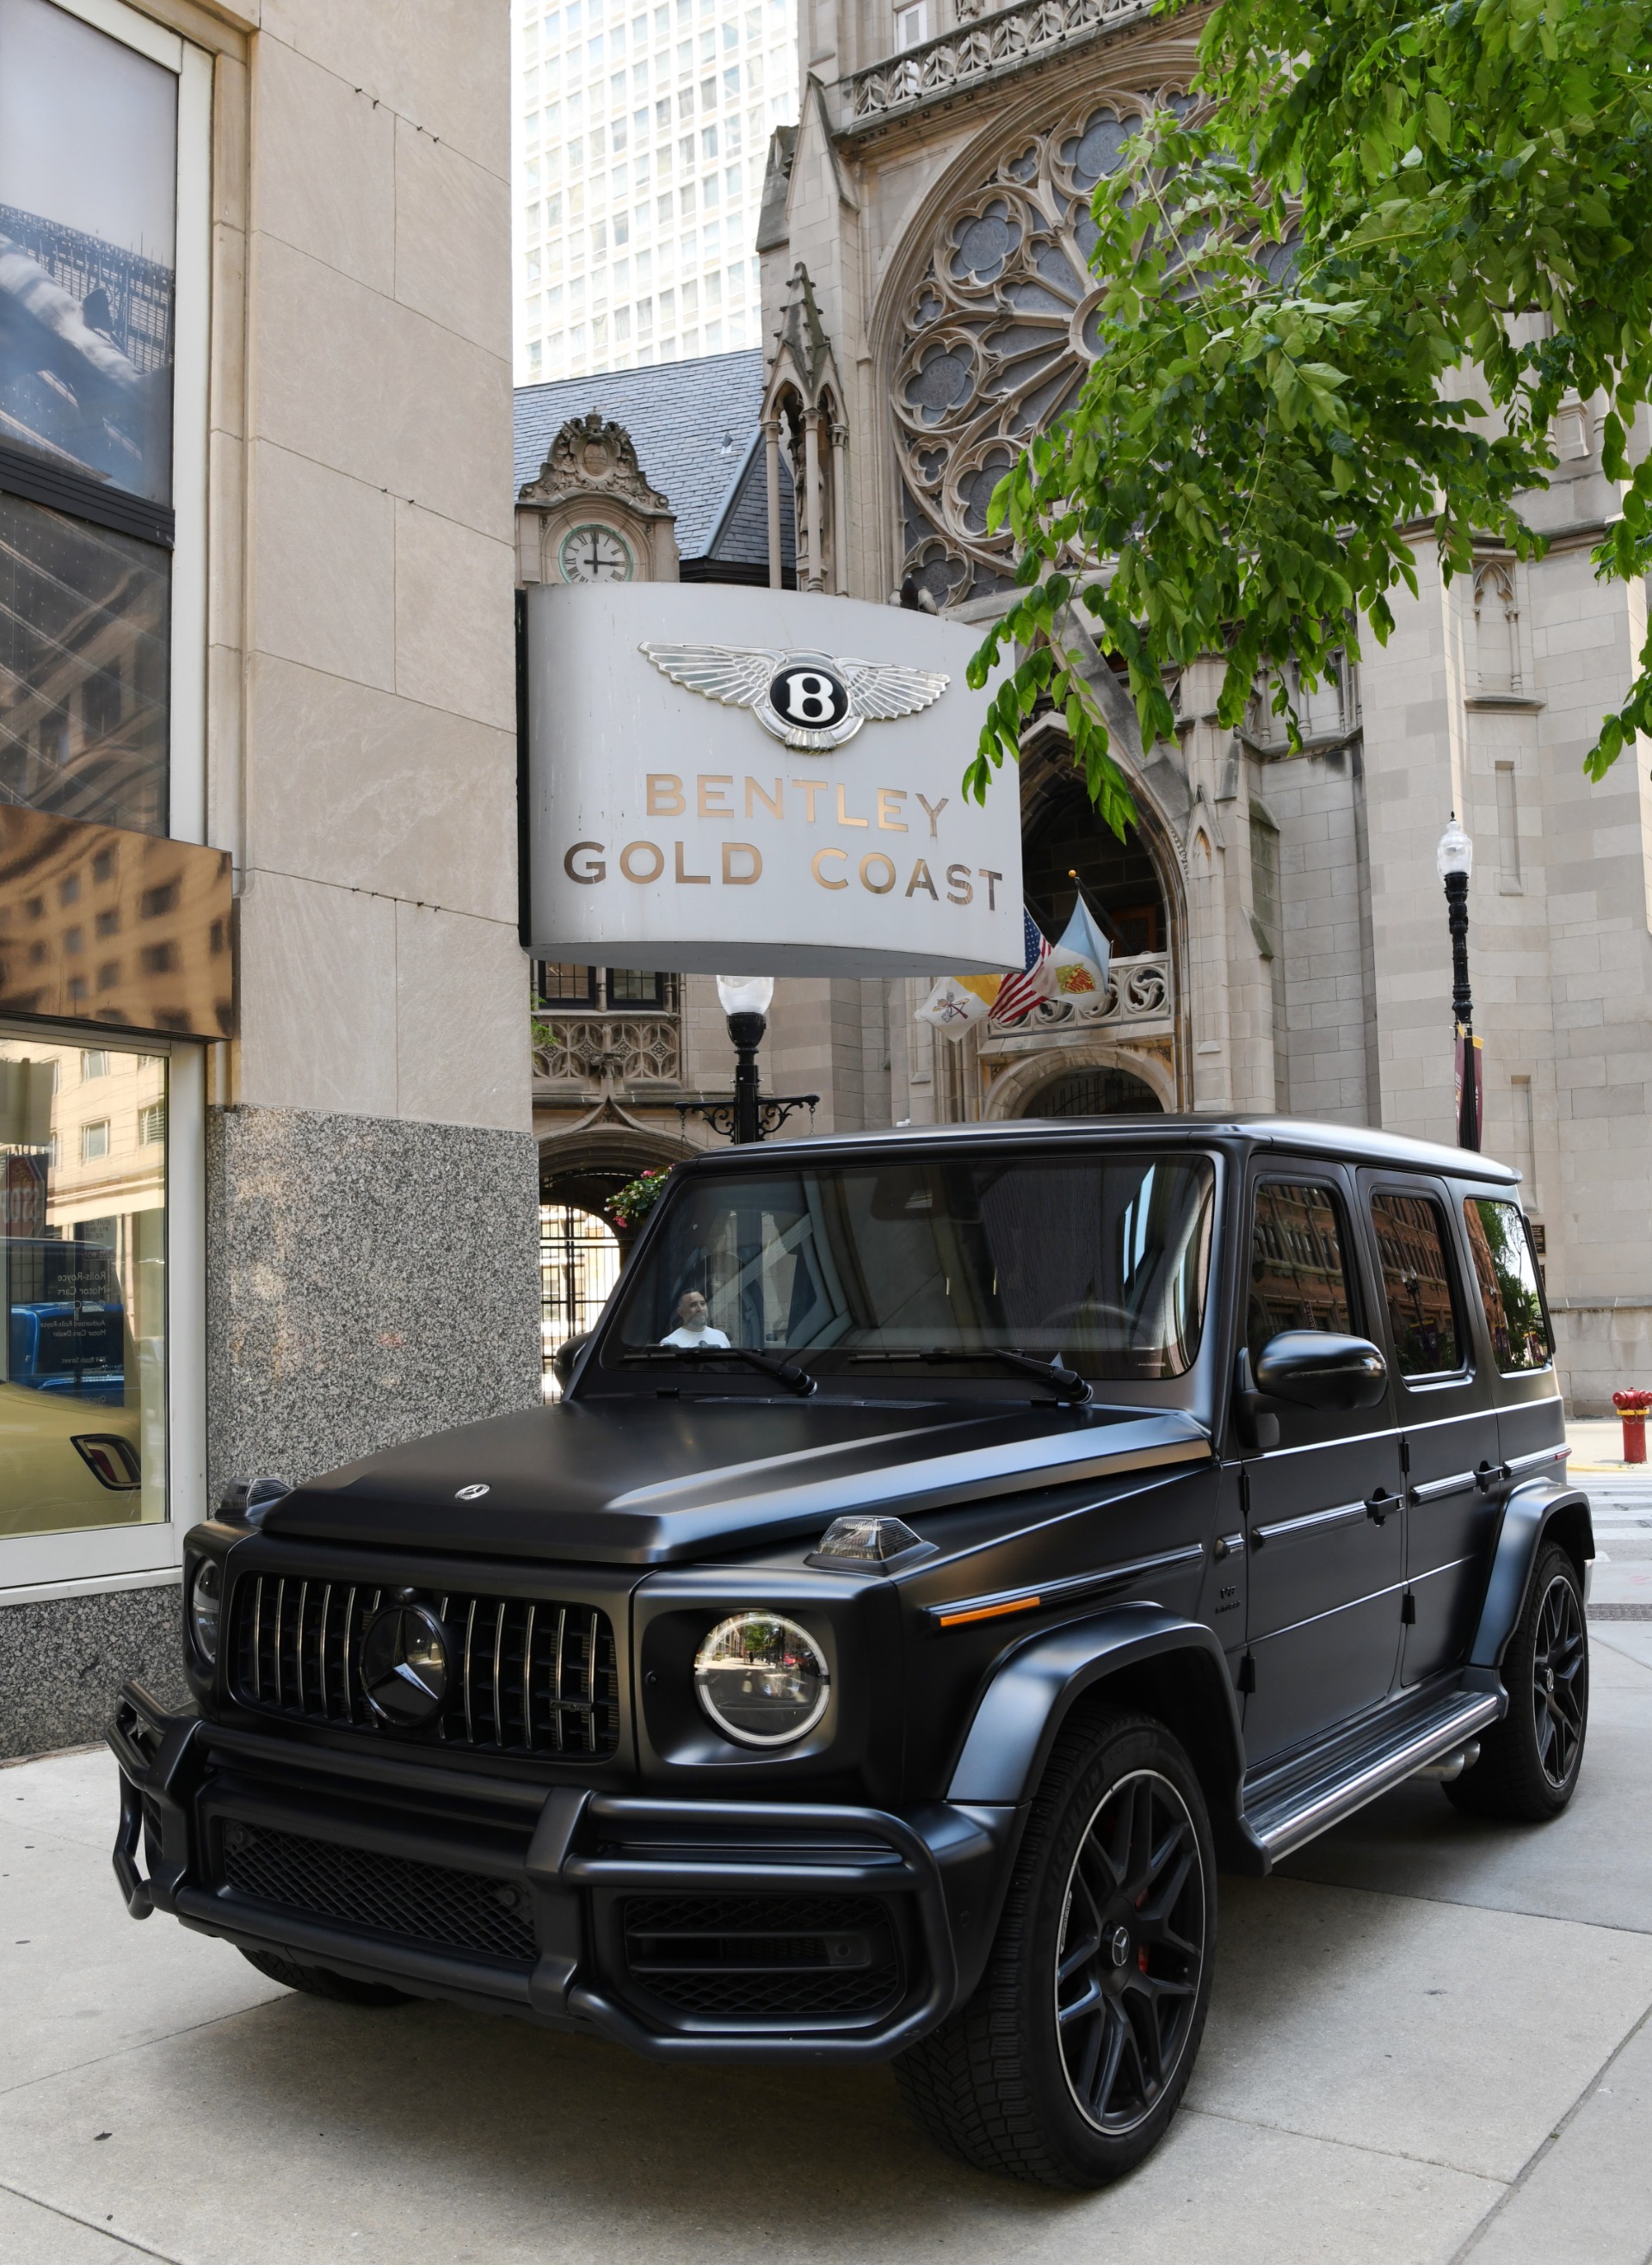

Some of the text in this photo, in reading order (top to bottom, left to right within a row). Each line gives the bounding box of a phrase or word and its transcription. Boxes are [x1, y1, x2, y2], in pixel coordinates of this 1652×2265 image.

[786, 672, 835, 723] B
[645, 773, 950, 836] BENTLEY
[564, 840, 1003, 911] GOLD COAST
